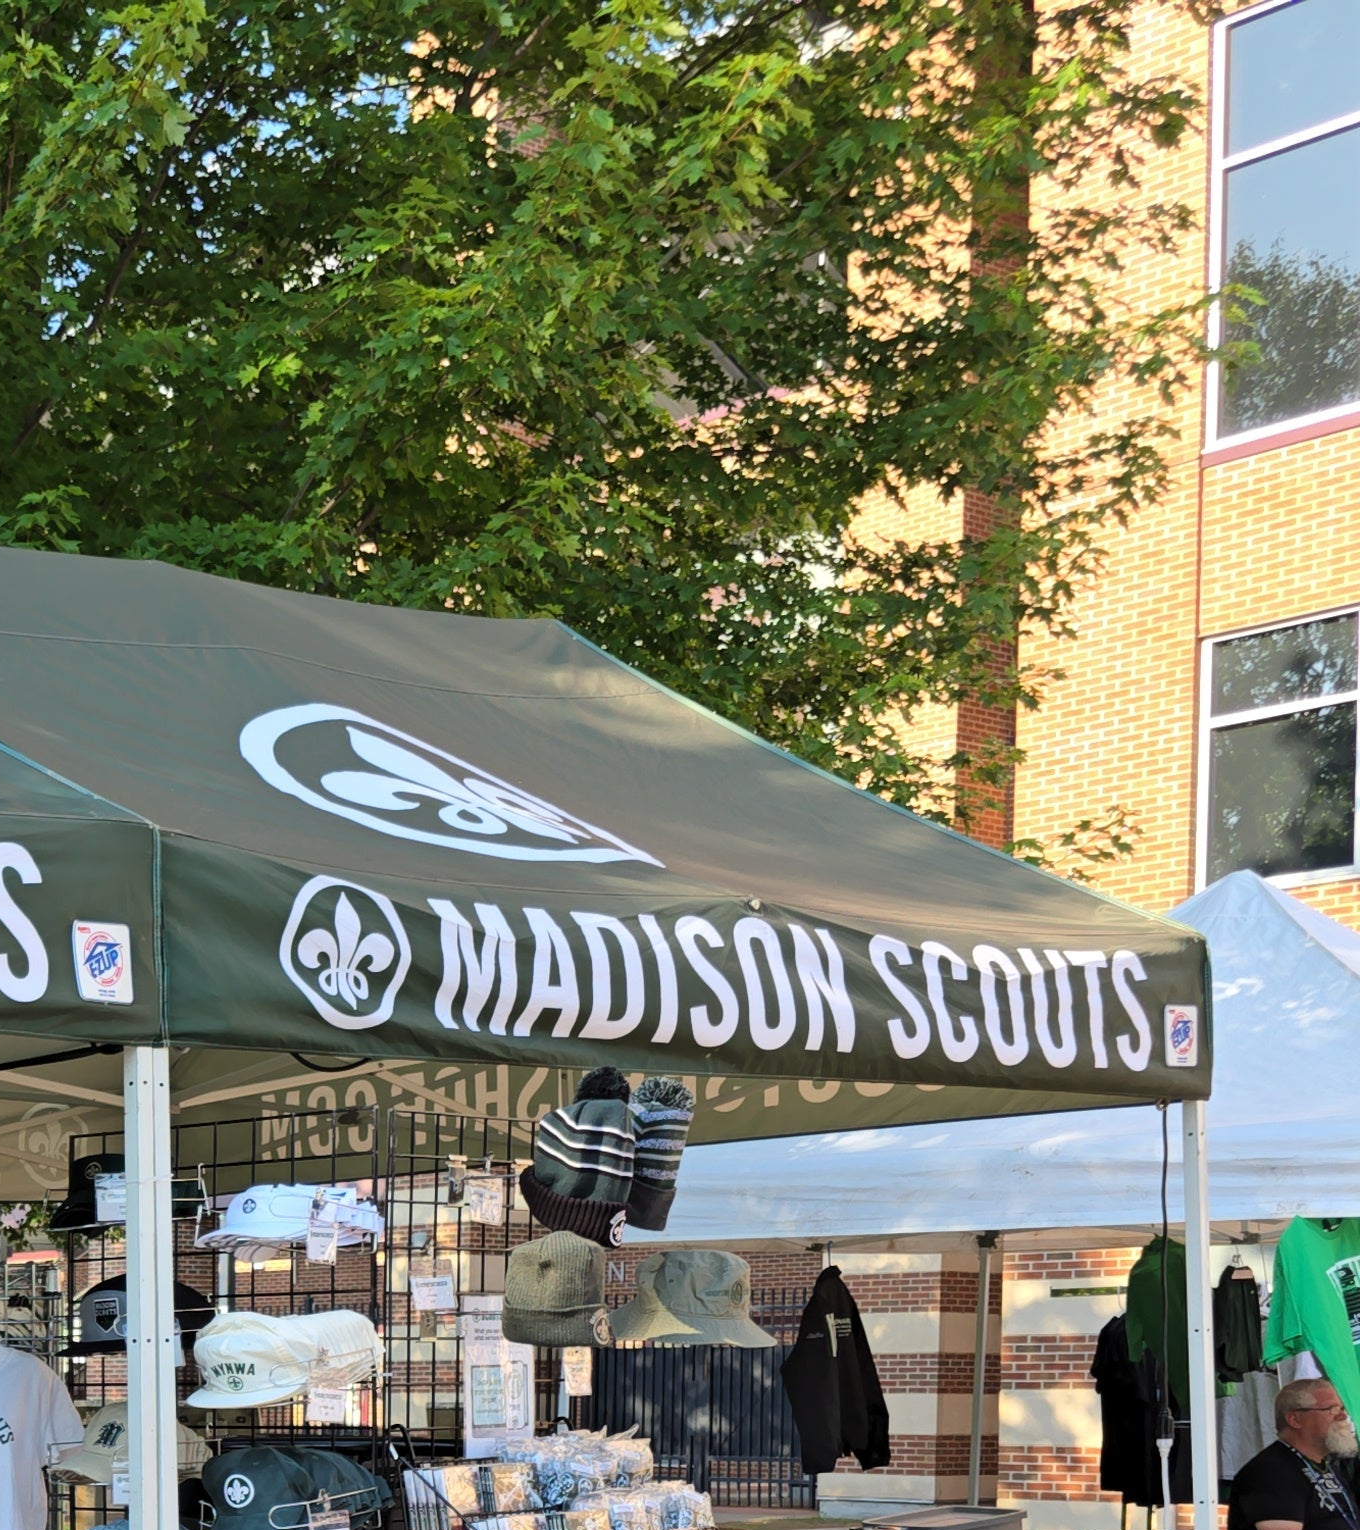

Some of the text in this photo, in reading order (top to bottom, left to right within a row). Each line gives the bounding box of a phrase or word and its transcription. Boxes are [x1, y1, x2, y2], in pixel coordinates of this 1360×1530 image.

[427, 898, 1154, 1071] MADISON SCOUTS
[211, 1362, 256, 1376] MYNWA
